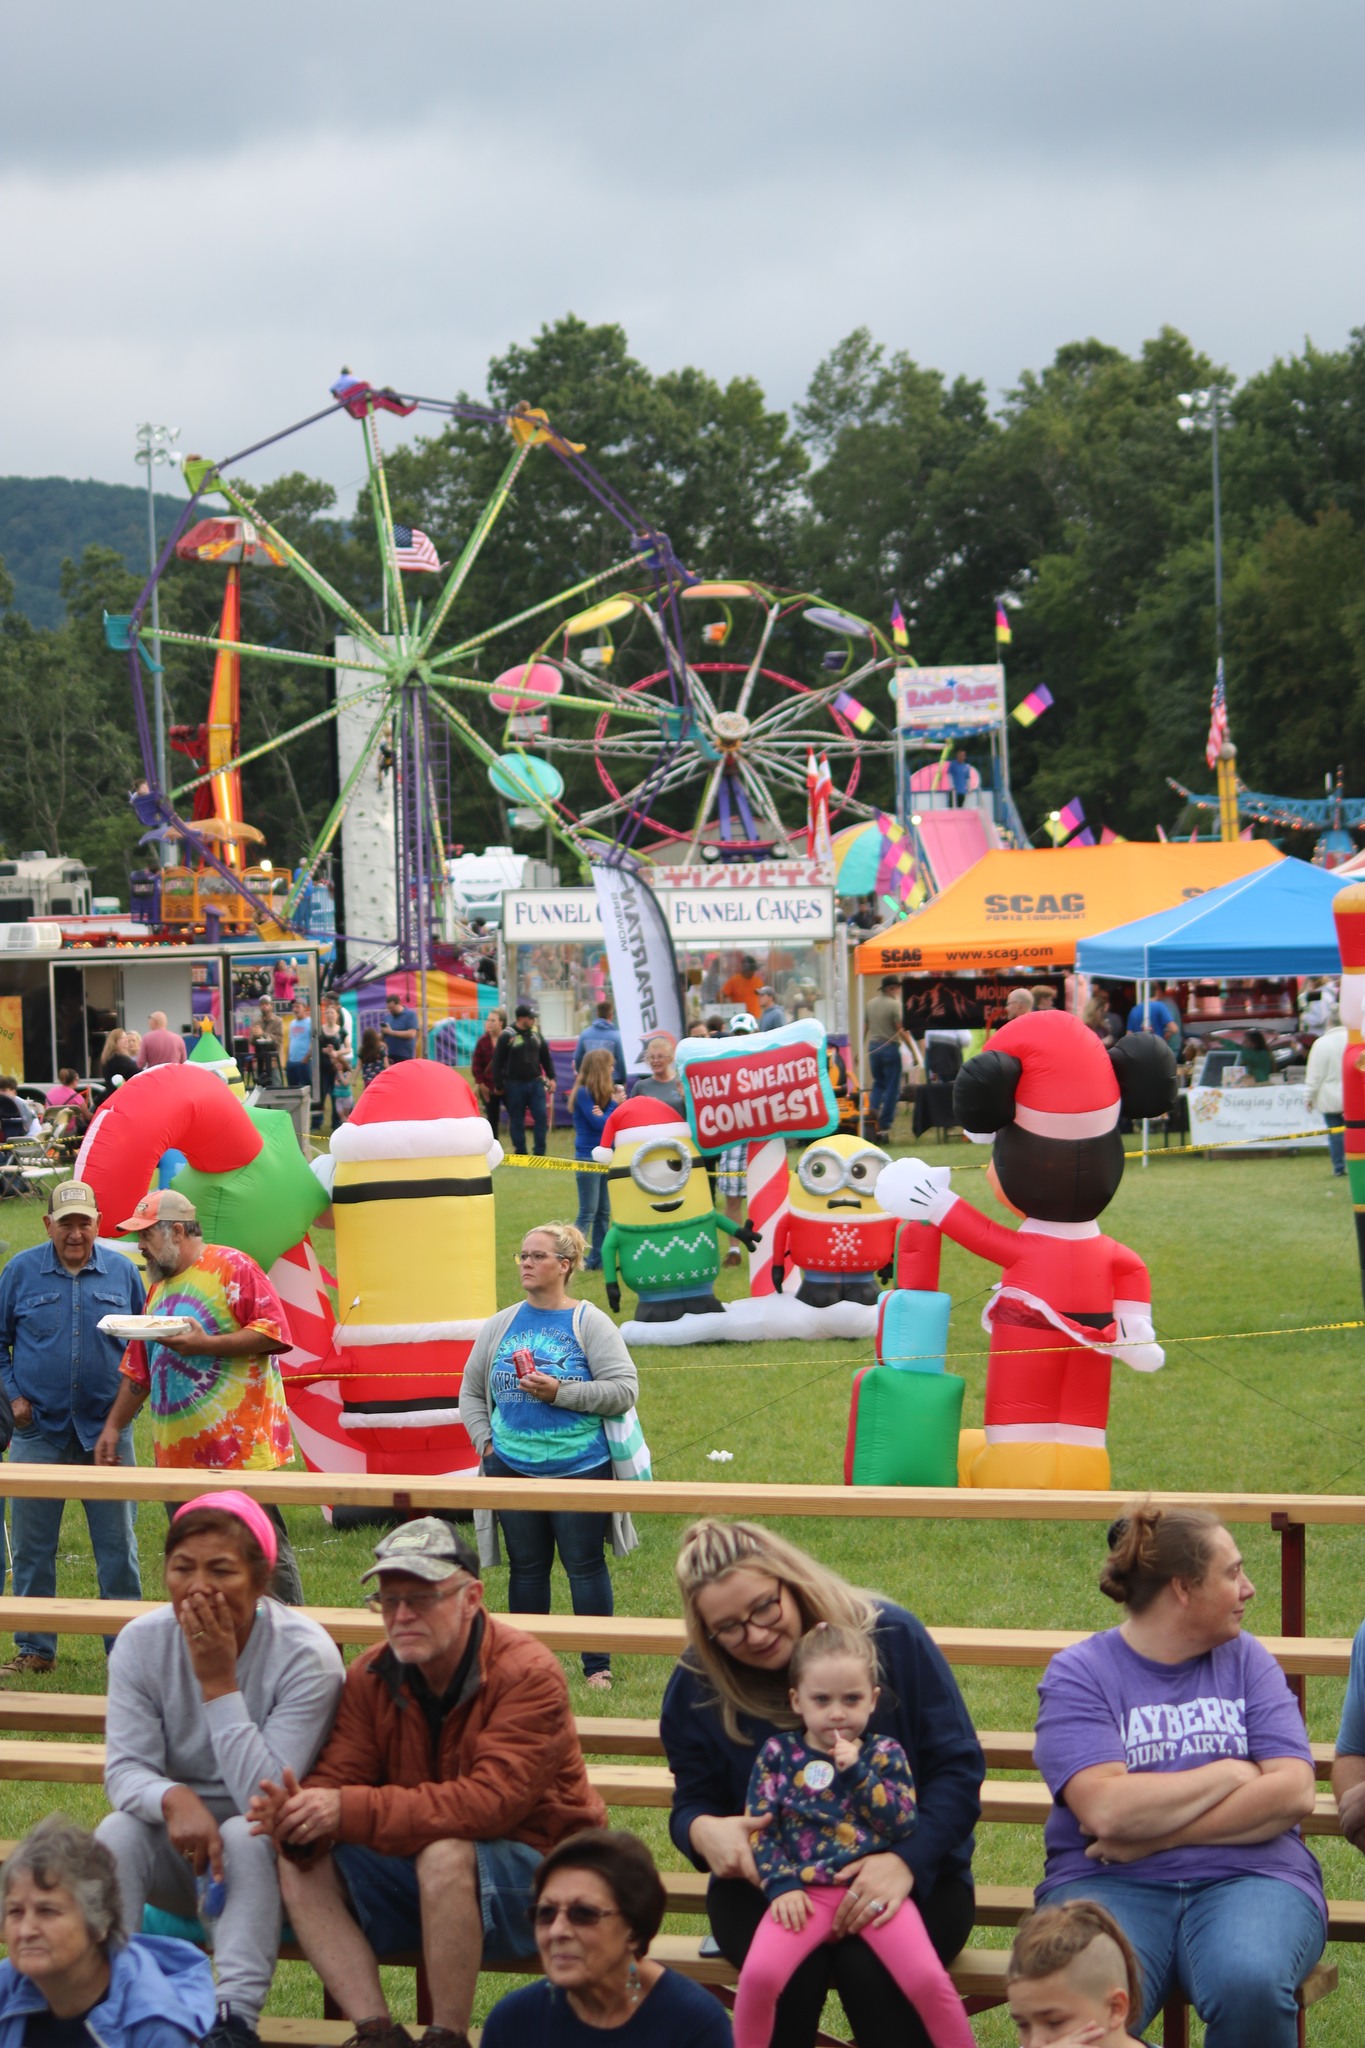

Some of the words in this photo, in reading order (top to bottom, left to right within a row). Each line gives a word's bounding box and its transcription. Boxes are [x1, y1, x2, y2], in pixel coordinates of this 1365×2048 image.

[515, 902, 591, 924] FUNNEL
[675, 901, 751, 924] FUNNEL
[756, 897, 823, 924] CAKES
[984, 893, 1086, 914] SCAG
[881, 948, 922, 963] SCAG
[946, 946, 1054, 961] www.scag.com
[690, 1073, 731, 1099] UGLY
[736, 1056, 818, 1094] SWEATER
[699, 1084, 821, 1136] CONTEST
[1223, 1093, 1273, 1111] Singing
[1277, 1093, 1305, 1110] Spri
[1125, 1740, 1178, 1769] OUNT
[1180, 1734, 1233, 1756] AIRY,
